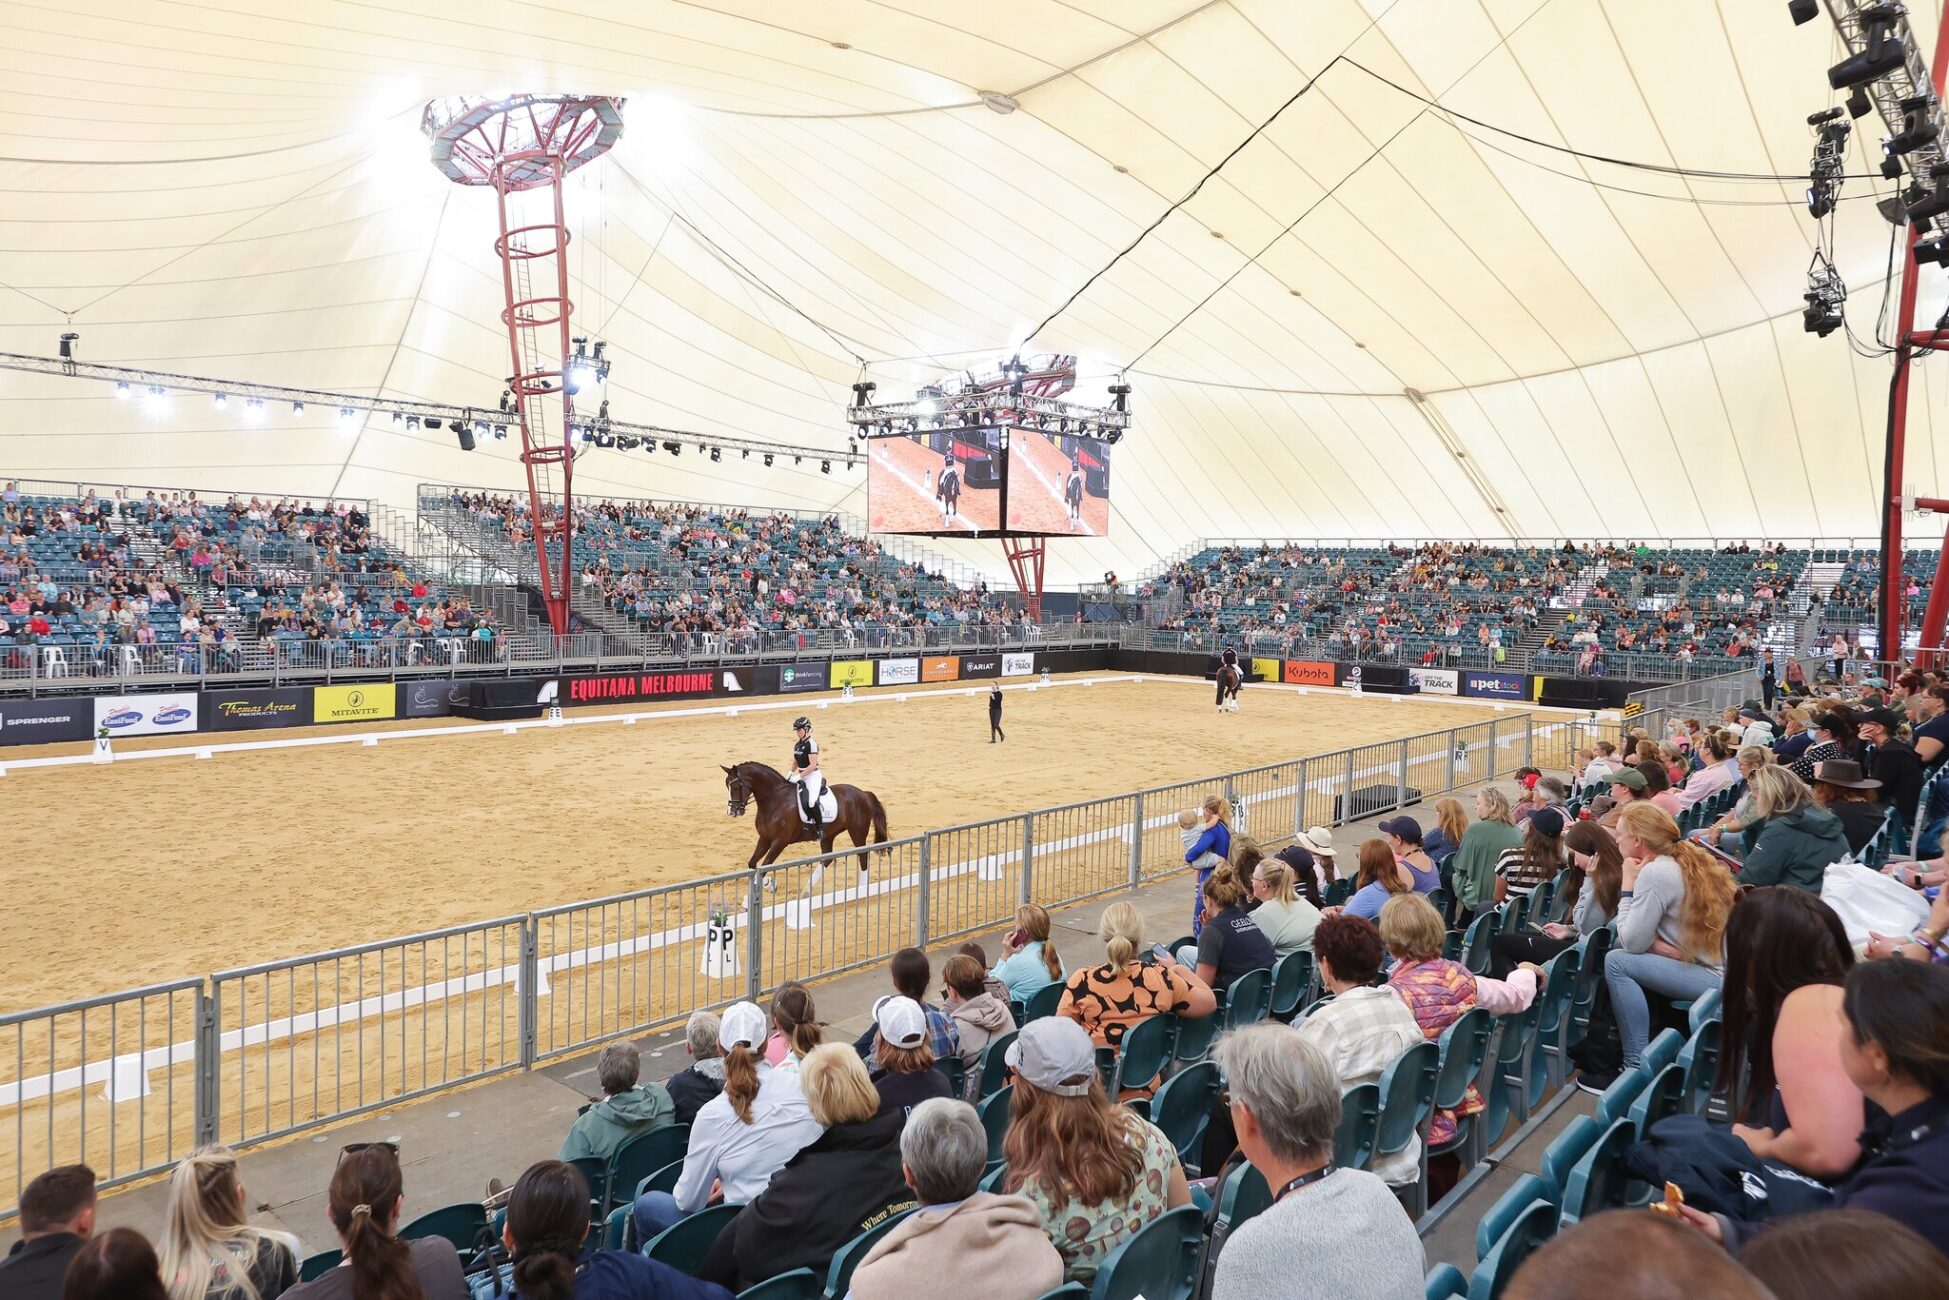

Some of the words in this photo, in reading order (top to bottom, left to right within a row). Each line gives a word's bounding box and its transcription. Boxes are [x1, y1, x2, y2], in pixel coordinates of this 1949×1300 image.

[881, 665, 916, 677] HORSE
[973, 662, 995, 671] ARIAT
[1288, 666, 1329, 679] Kubota
[571, 676, 636, 700] EQUITANA
[641, 672, 713, 695] MELBOURNE
[1424, 680, 1453, 689] TRACK
[1478, 679, 1520, 690] petstock
[218, 701, 262, 717] Thomas
[264, 701, 297, 712] Arena
[331, 708, 379, 717] MITAVITE
[6, 716, 71, 726] SPRENGER
[100, 740, 108, 751] V
[709, 928, 717, 949] P
[722, 929, 734, 951] P
[726, 953, 731, 963] L
[861, 1210, 888, 1231] Where
[887, 1200, 920, 1215] Tomorr
